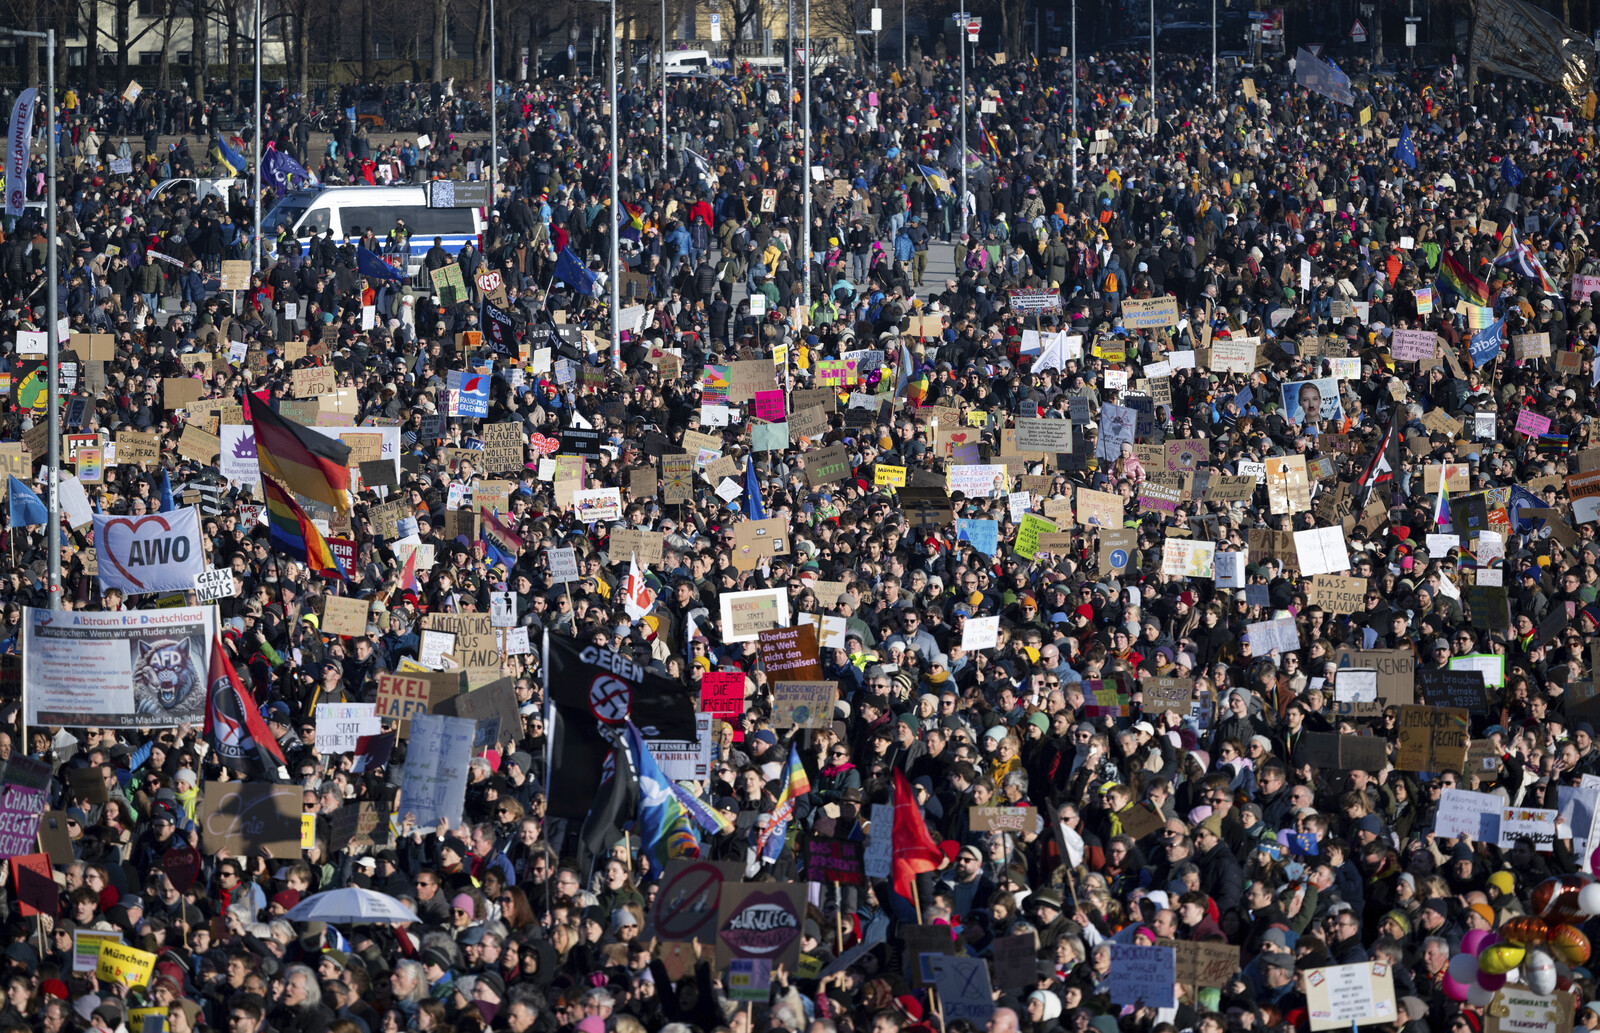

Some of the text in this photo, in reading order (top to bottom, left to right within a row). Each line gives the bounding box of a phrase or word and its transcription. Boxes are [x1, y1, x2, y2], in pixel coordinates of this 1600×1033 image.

[14, 102, 28, 182] JOHANNITER
[478, 271, 500, 290] HERZ
[1142, 299, 1176, 307] MEHRHEITEN
[486, 305, 511, 326] GEGEN
[1123, 308, 1175, 319] VERFASSUNGS
[307, 384, 324, 395] AFD
[460, 396, 487, 406] RASSISMUS
[488, 423, 519, 433] ALS WIR
[485, 432, 521, 441] FRAUEN
[485, 440, 501, 449] MEHR
[351, 447, 371, 455] STATT
[821, 451, 838, 459] wieder
[485, 456, 522, 465] MEINTEN WIR
[663, 459, 691, 473] VIELFALT
[815, 462, 845, 478] JETZT!
[1220, 475, 1251, 484] BLAU
[478, 486, 501, 495] HASS
[1141, 481, 1181, 496] FAZIT EINER
[1212, 490, 1245, 498] NULLE
[240, 505, 257, 514] HASS
[377, 515, 384, 524] 5
[396, 509, 407, 518] 12
[375, 520, 394, 532] ES IST
[1261, 530, 1289, 549] AFD
[127, 535, 190, 567] AWO
[550, 551, 573, 560] EXTREME
[1166, 550, 1185, 558] BRAND
[197, 569, 231, 584] GEN X
[1317, 577, 1347, 588] HASS
[203, 580, 223, 588] GEGEN
[197, 583, 232, 601] NAZIS
[1316, 590, 1363, 602] IST KEINE
[1316, 600, 1365, 612] MEINUNG
[73, 612, 203, 626] Albtraum für Deutschland
[747, 612, 764, 620] STATT
[89, 630, 112, 638] Wenn
[113, 630, 127, 638] wir
[143, 628, 167, 637] Ruder
[760, 629, 799, 644] Überlasst
[763, 640, 797, 653] die Welt
[152, 650, 182, 667] AFD
[764, 650, 802, 663] nicht den
[579, 645, 644, 683] GEGEN
[766, 658, 820, 672] Schreihälsen.
[1376, 655, 1414, 675] KENEN
[703, 672, 742, 683] ES LEBE
[1159, 679, 1174, 687] KEIN
[1423, 673, 1480, 685] Wir brauchen
[380, 675, 428, 700] EKEL
[713, 684, 729, 696] DIE
[775, 683, 833, 694] MENSCHENRECHTE
[1147, 687, 1188, 700] GLITZER
[1426, 685, 1479, 697] kein Remake
[777, 693, 789, 701] SIND
[801, 691, 815, 700] ALLE
[702, 698, 744, 712] FREIHEIT
[1434, 700, 1450, 708] von
[120, 716, 134, 725] Die
[136, 715, 161, 724] Maske
[163, 715, 172, 723] ist
[1404, 709, 1450, 728] MENSCHEN
[336, 722, 361, 734] STATT
[316, 735, 342, 746] RECHTE
[648, 742, 701, 751] IST BESSER ALS
[1433, 731, 1467, 750] RECHTE
[0, 812, 38, 836] GEGEN
[987, 815, 1025, 830] LIEBE
[167, 853, 194, 867] DEMO
[730, 910, 756, 931] YOUR
[102, 946, 150, 968] München
[101, 961, 143, 983] ist bunt!
[1508, 997, 1549, 1008] DEMOKRATIE
[1508, 1019, 1550, 1030] TEAMSPORT
